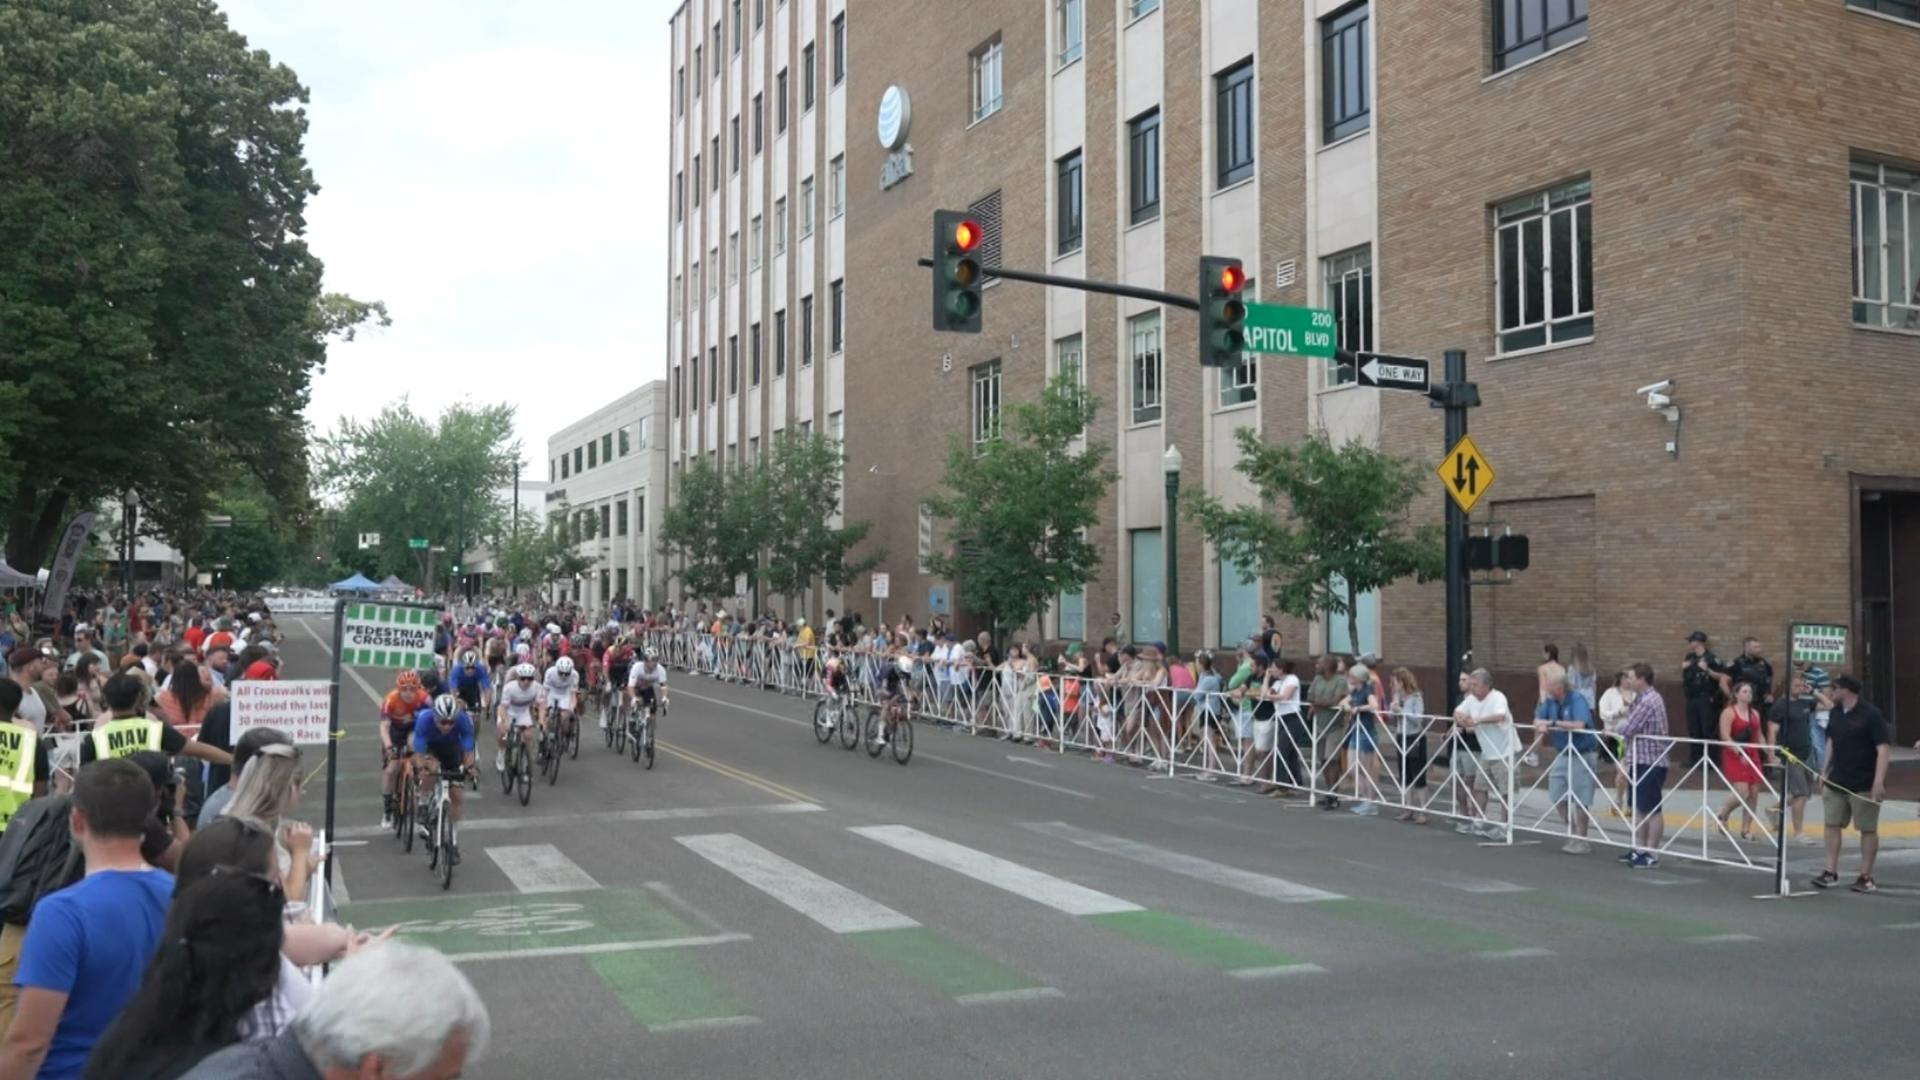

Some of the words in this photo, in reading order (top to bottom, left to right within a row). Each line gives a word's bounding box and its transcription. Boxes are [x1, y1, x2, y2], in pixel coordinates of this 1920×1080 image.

[1311, 311, 1332, 328] 200
[1242, 325, 1298, 352] APITOL
[1304, 331, 1329, 347] BLVD
[1378, 365, 1399, 379] ONE
[1402, 367, 1423, 381] WAY
[346, 625, 433, 640] PEDESTRIAN
[352, 635, 425, 649] CROSSING
[237, 686, 250, 696] All
[253, 686, 310, 696] Crosswalks
[238, 700, 251, 710] be
[254, 700, 287, 710] closed
[290, 700, 306, 710] the
[309, 700, 328, 709] last
[253, 716, 294, 725] minutes
[297, 715, 308, 725] of
[311, 715, 326, 724] the
[0, 731, 21, 750] AV
[108, 727, 148, 751] MAV
[297, 729, 321, 739] Race
